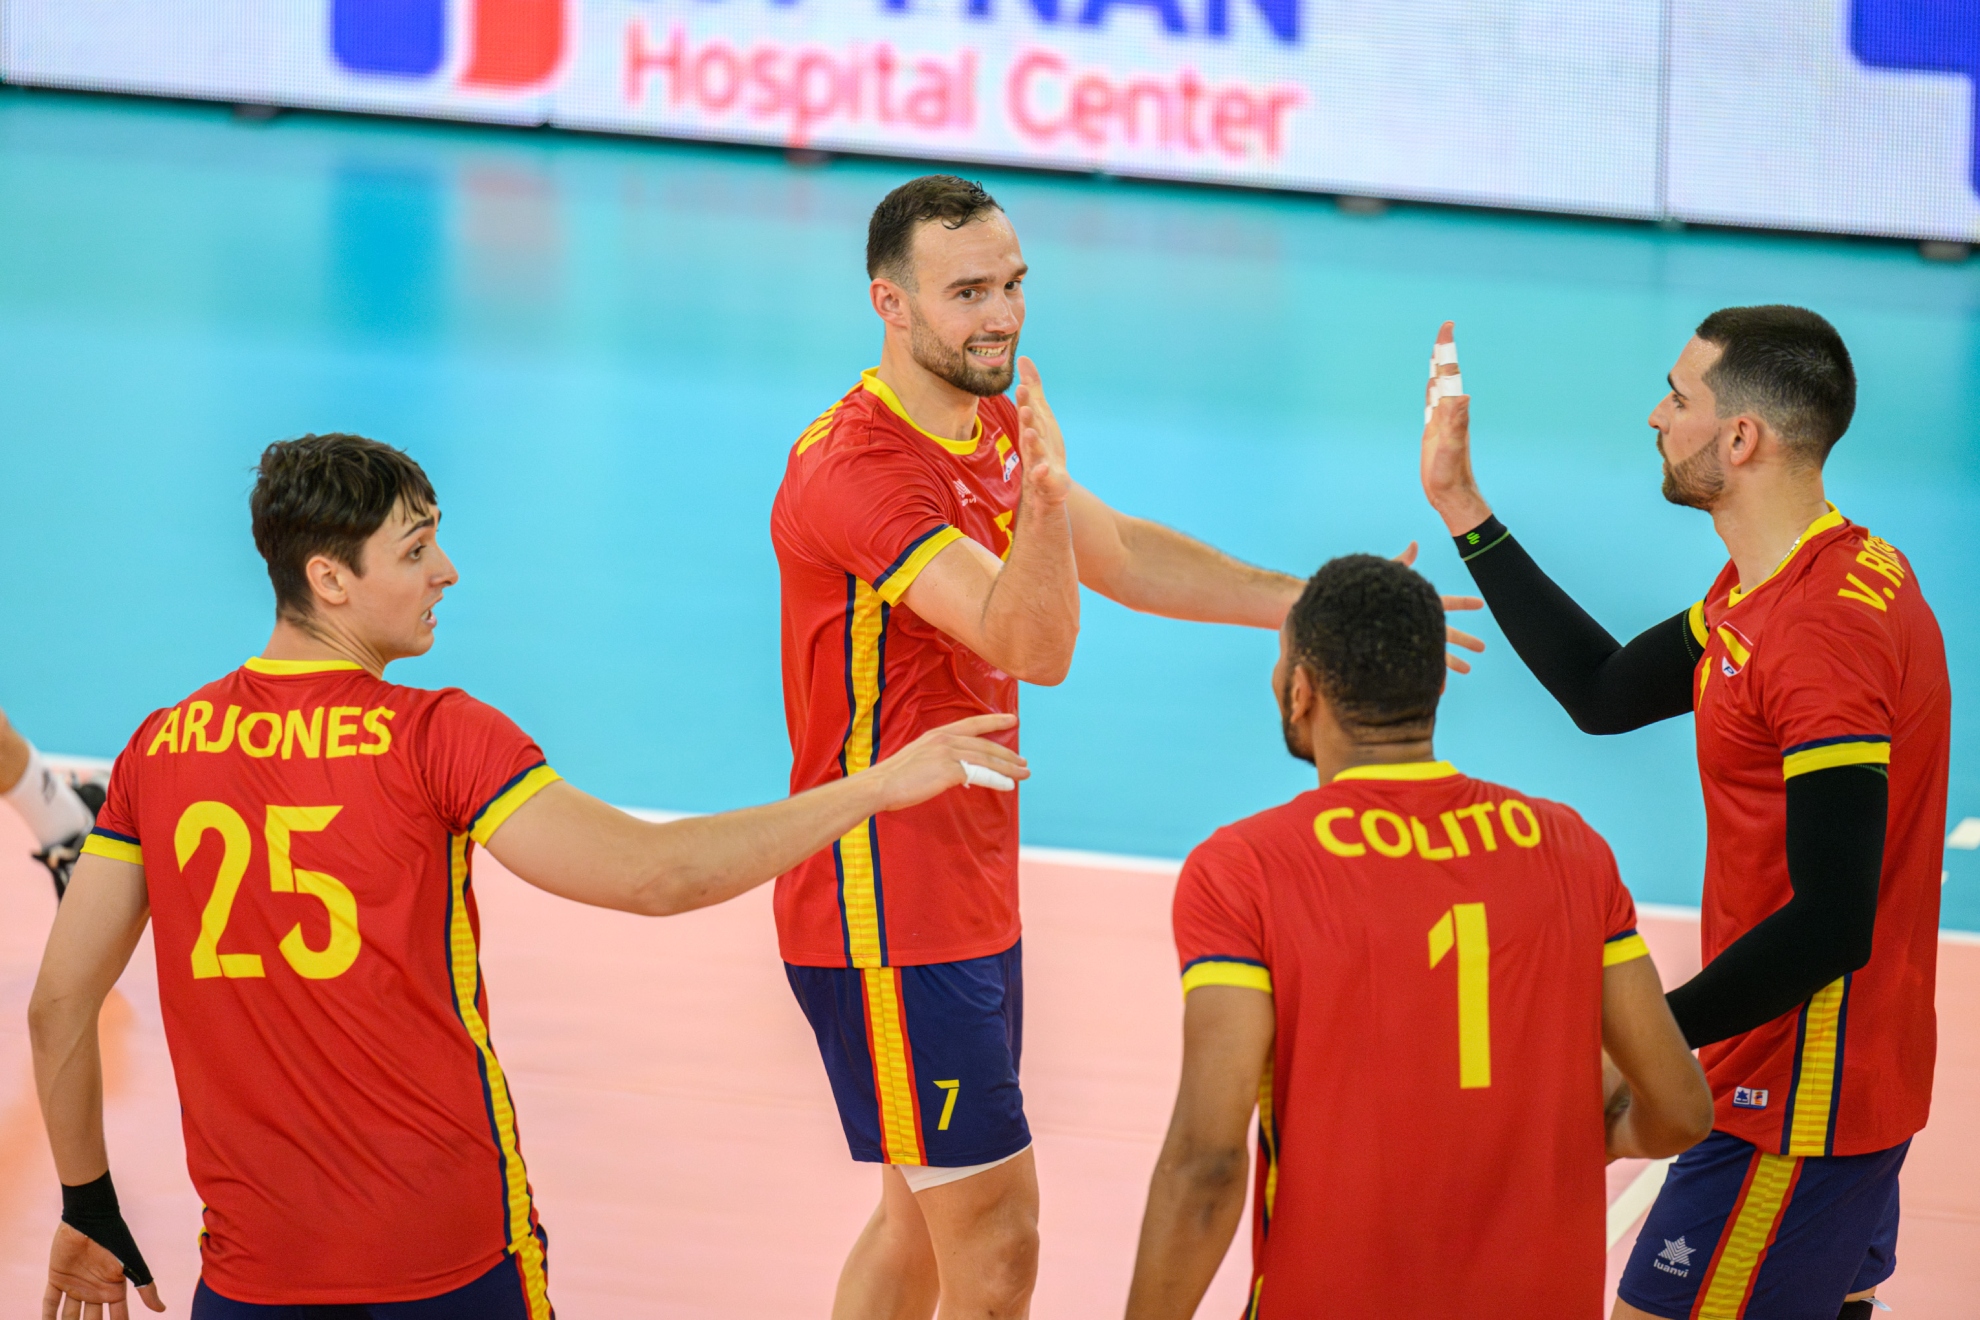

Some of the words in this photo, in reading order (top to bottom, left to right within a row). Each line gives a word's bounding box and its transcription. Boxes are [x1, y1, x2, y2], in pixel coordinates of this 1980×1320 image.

[624, 15, 980, 152] Hospital
[1005, 45, 1309, 160] Center
[147, 700, 396, 760] ARJONES
[1313, 799, 1541, 861] COLITO
[174, 800, 361, 980] 25
[1428, 902, 1491, 1089] 1
[932, 1079, 960, 1130] 7
[1653, 1258, 1689, 1278] luanvi
